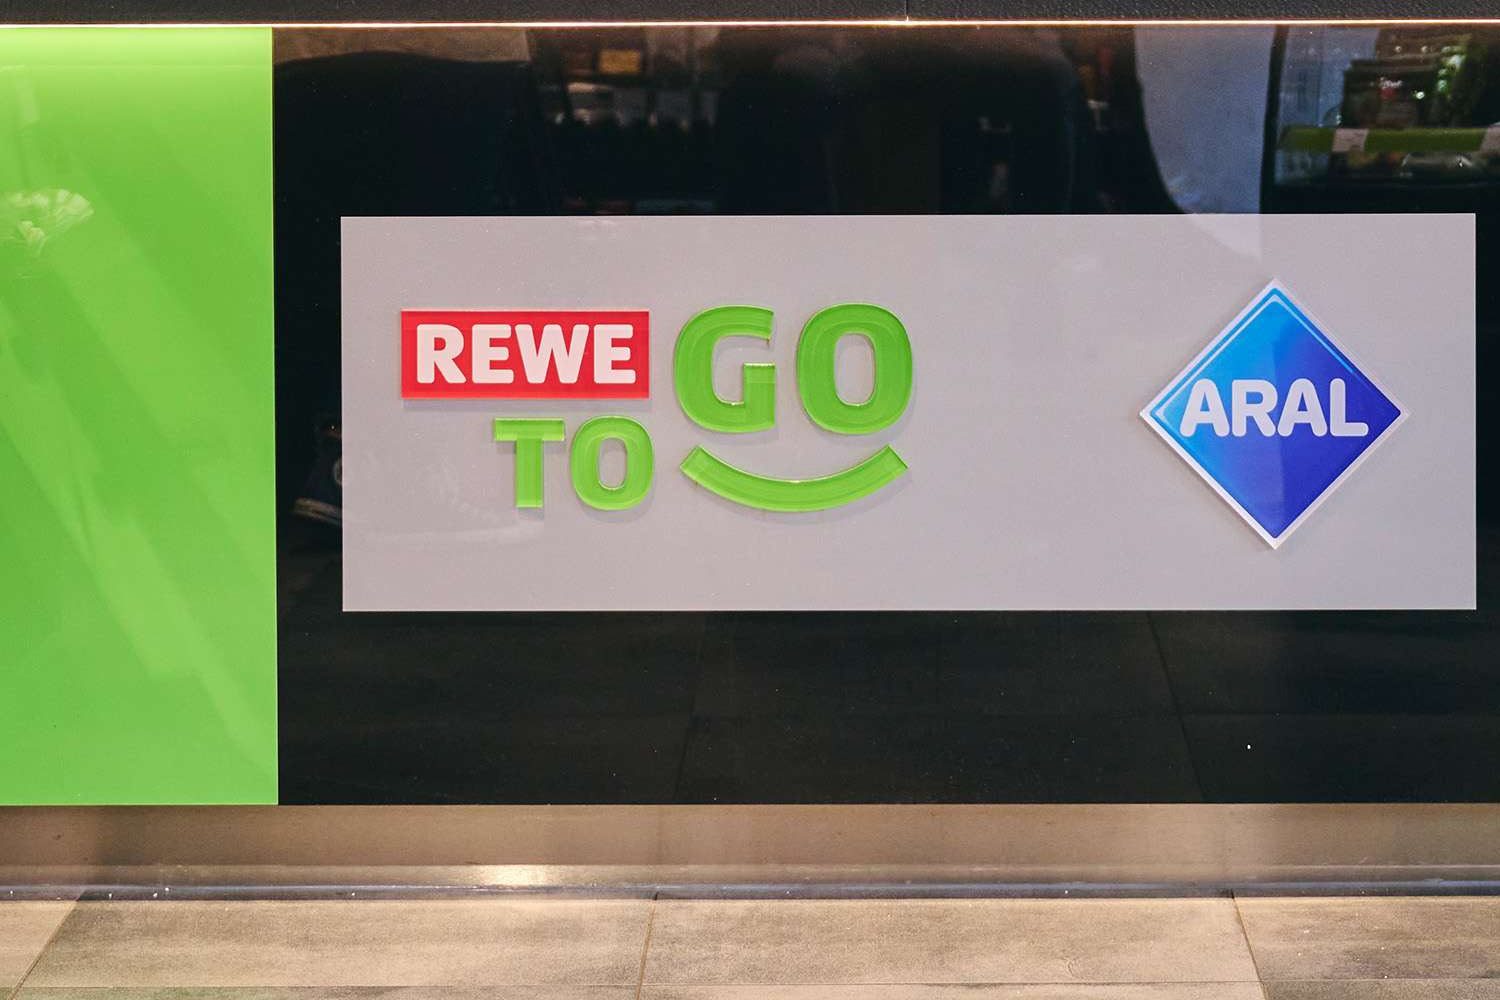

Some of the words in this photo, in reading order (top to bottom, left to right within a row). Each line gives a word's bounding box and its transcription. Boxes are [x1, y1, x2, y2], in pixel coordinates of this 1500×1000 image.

[415, 324, 637, 385] REWE
[673, 302, 916, 435] GO
[1180, 377, 1371, 438] ARAL
[493, 416, 655, 510] TO
